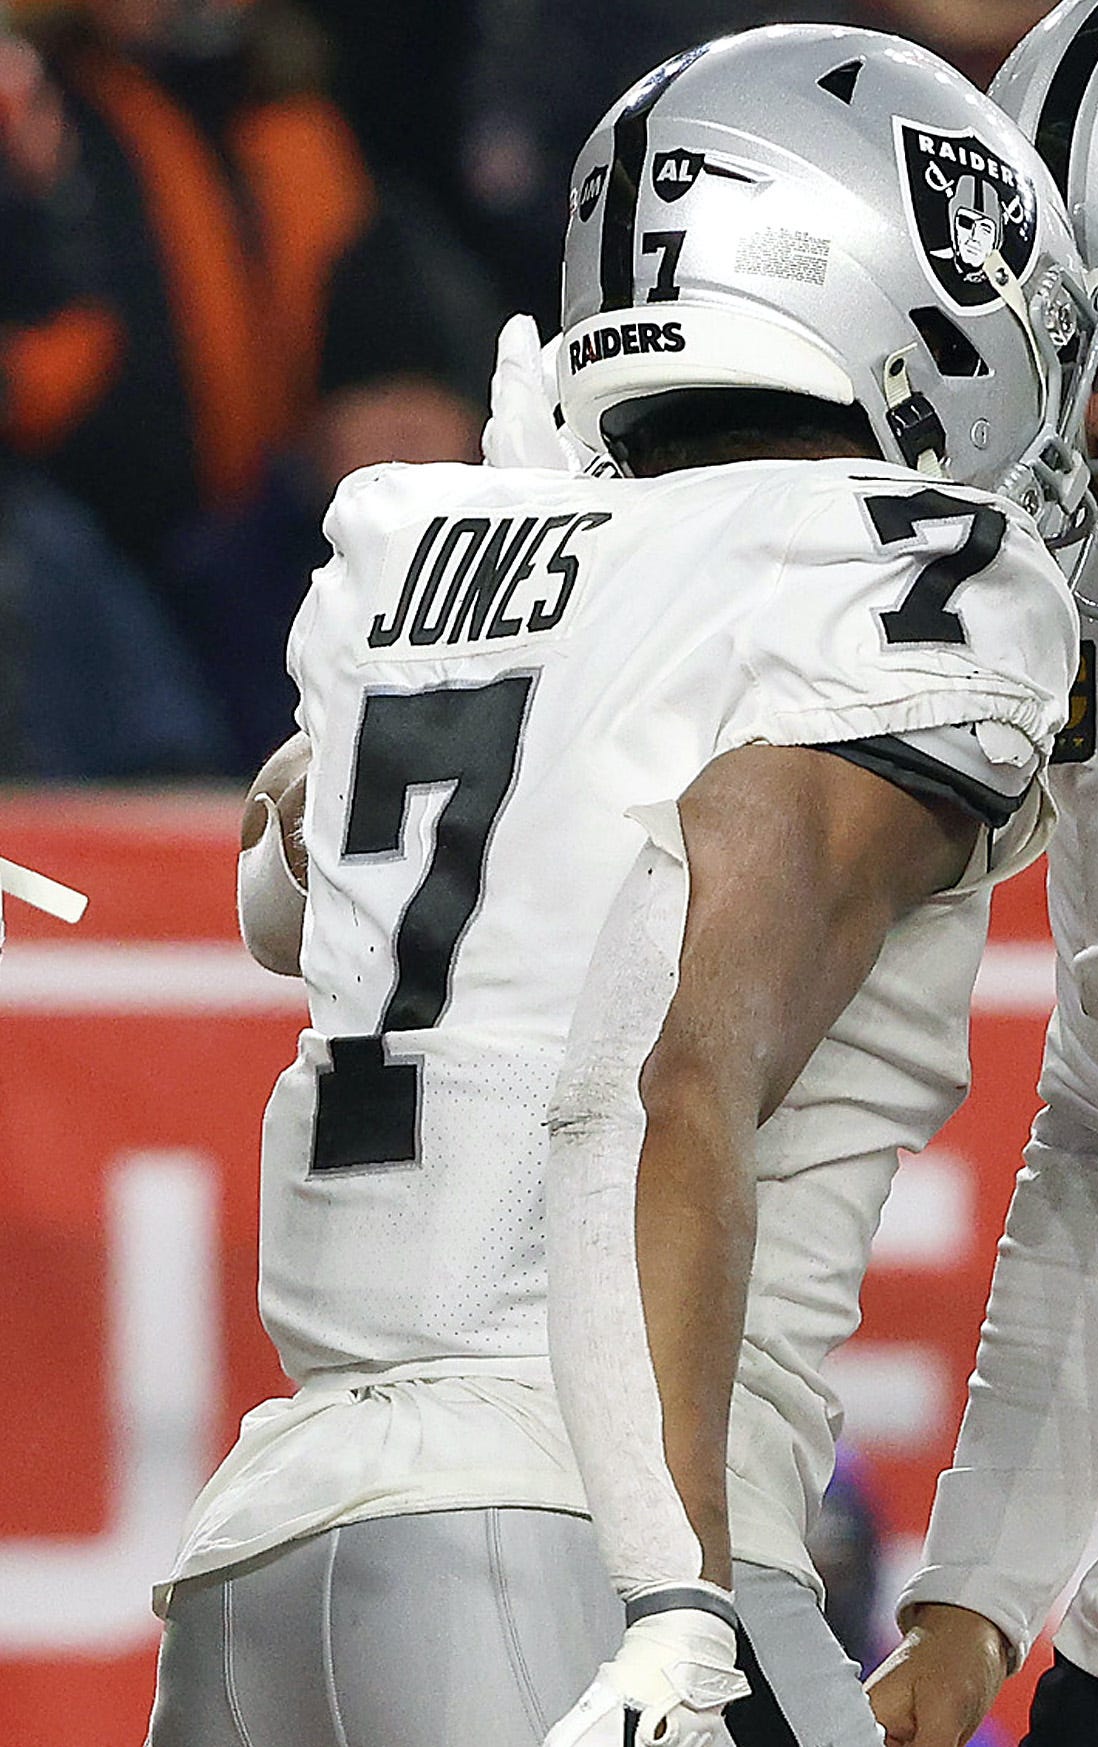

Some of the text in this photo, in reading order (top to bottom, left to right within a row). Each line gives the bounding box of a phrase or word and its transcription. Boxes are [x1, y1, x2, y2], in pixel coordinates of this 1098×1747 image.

[656, 158, 693, 182] AL
[918, 133, 1022, 192] RAIDER
[641, 229, 687, 303] 7
[569, 321, 686, 376] RAIDERS
[367, 511, 613, 649] JONES
[860, 486, 1010, 648] 7
[306, 668, 542, 1180] 7
